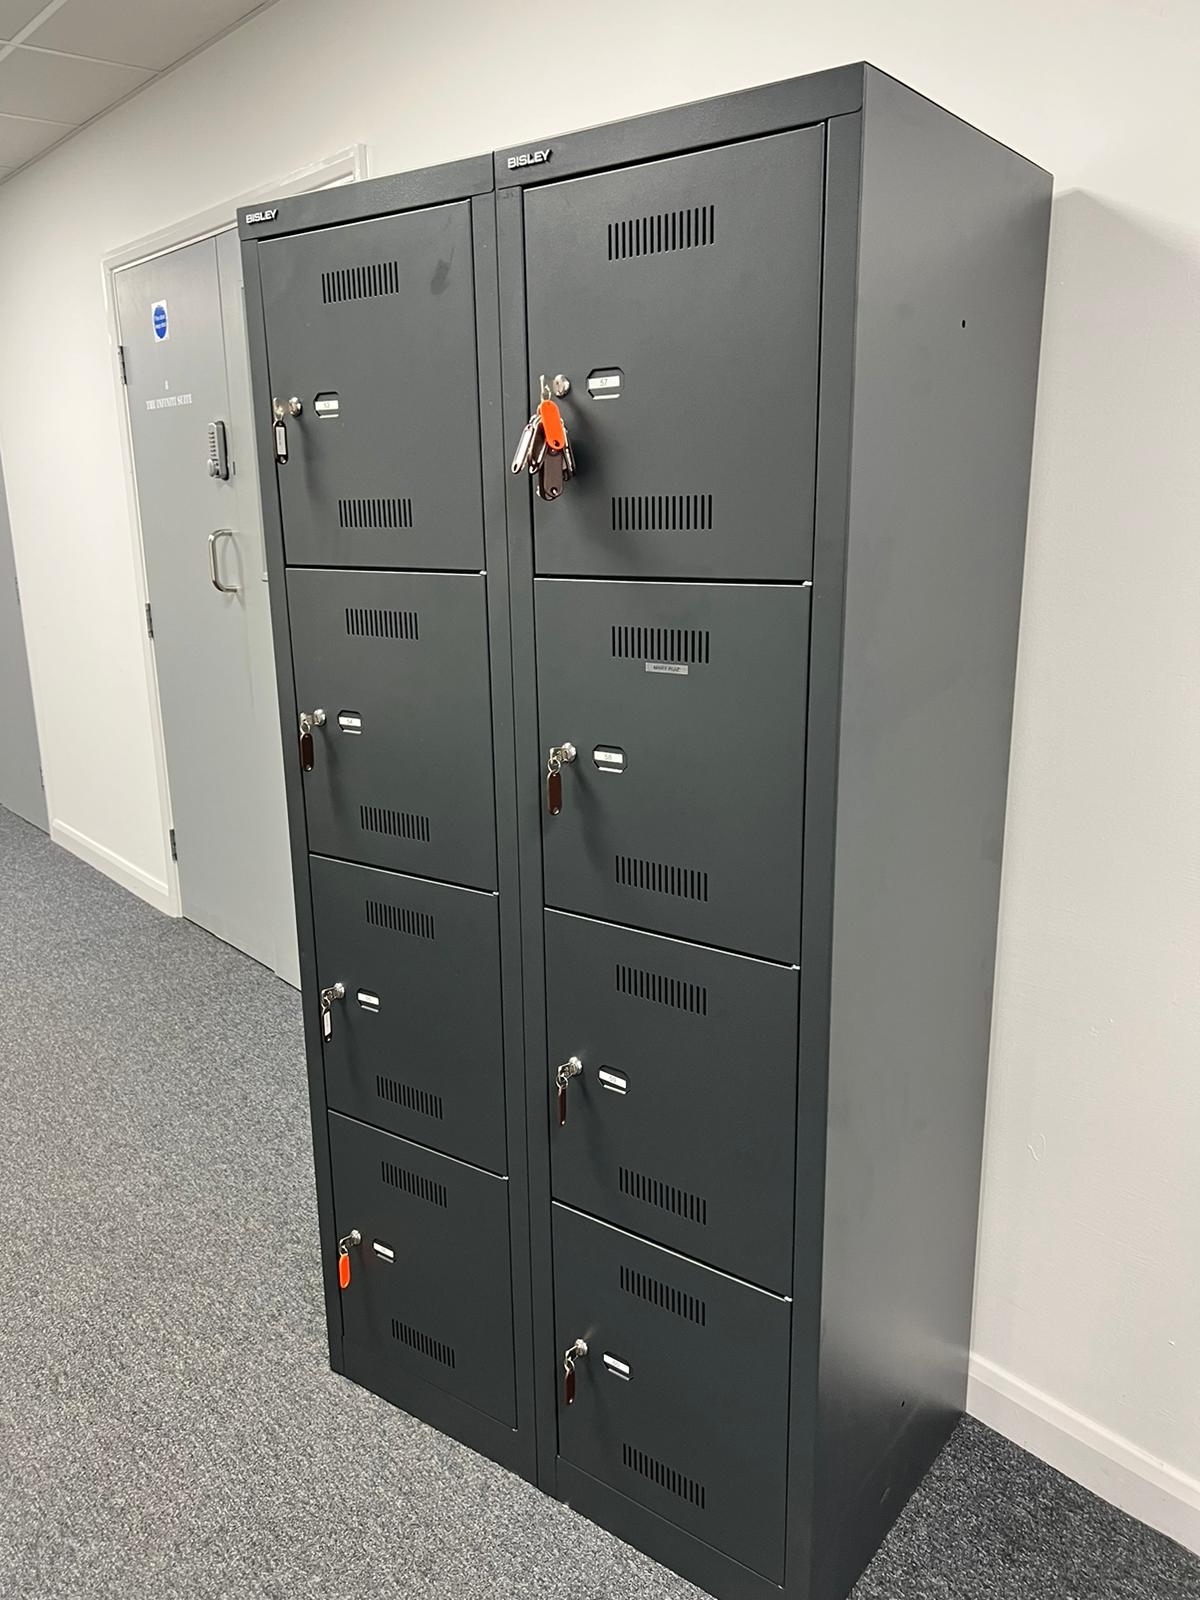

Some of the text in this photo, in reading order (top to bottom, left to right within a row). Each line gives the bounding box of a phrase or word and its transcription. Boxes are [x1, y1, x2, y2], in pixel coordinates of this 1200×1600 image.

[507, 149, 550, 169] BISLEY
[245, 208, 277, 224] BISLEY
[600, 378, 608, 387] 57
